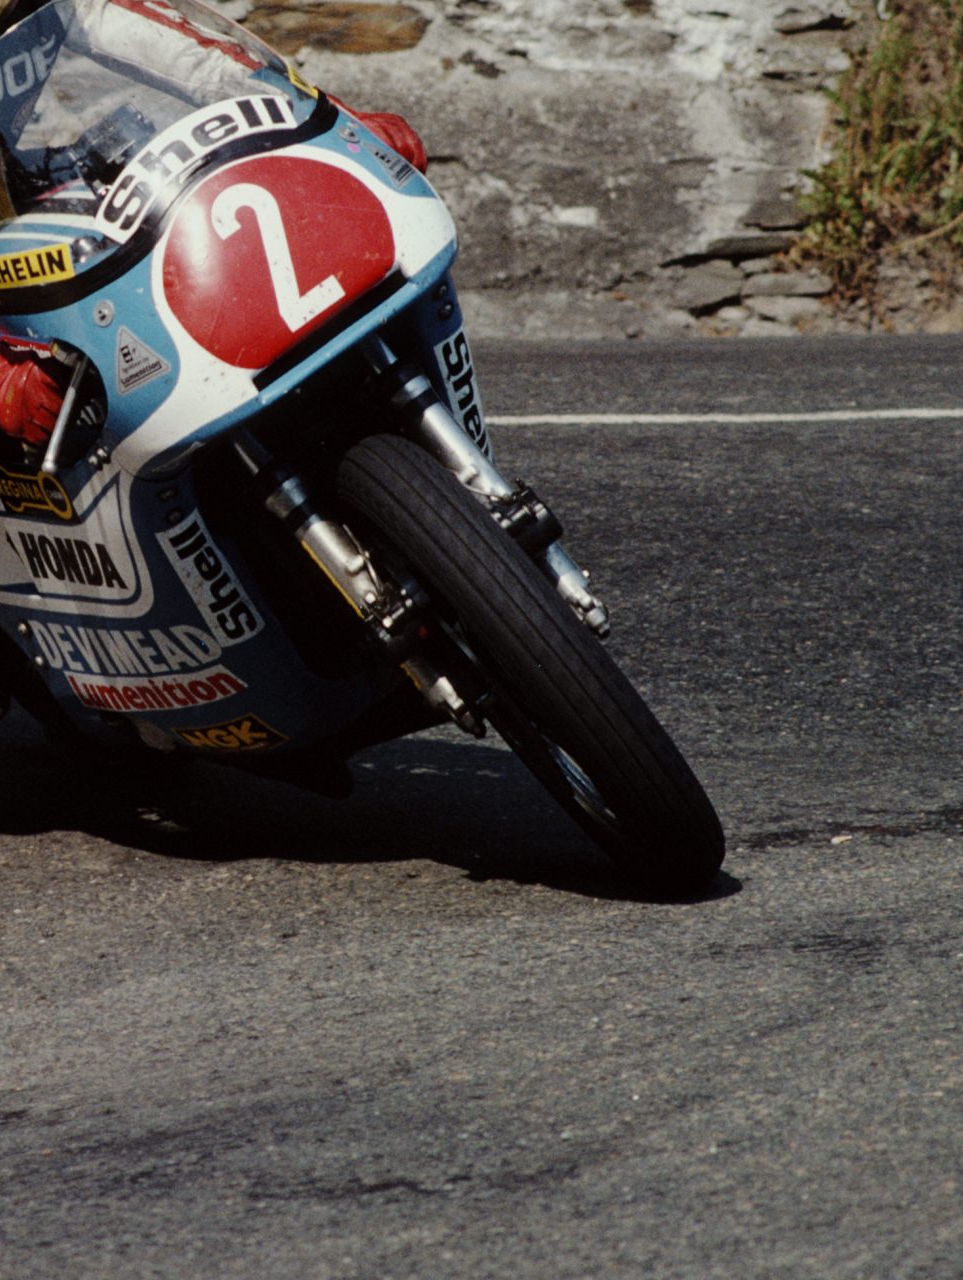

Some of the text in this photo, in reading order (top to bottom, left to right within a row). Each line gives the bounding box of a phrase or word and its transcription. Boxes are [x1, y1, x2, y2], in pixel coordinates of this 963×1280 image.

[102, 98, 287, 231] Shell
[210, 182, 347, 334] 2
[17, 530, 130, 591] HONDA
[168, 521, 259, 641] Shell
[27, 619, 223, 674] DEVIMEAD
[67, 671, 246, 711] Lumenition
[180, 719, 268, 750] NGK
